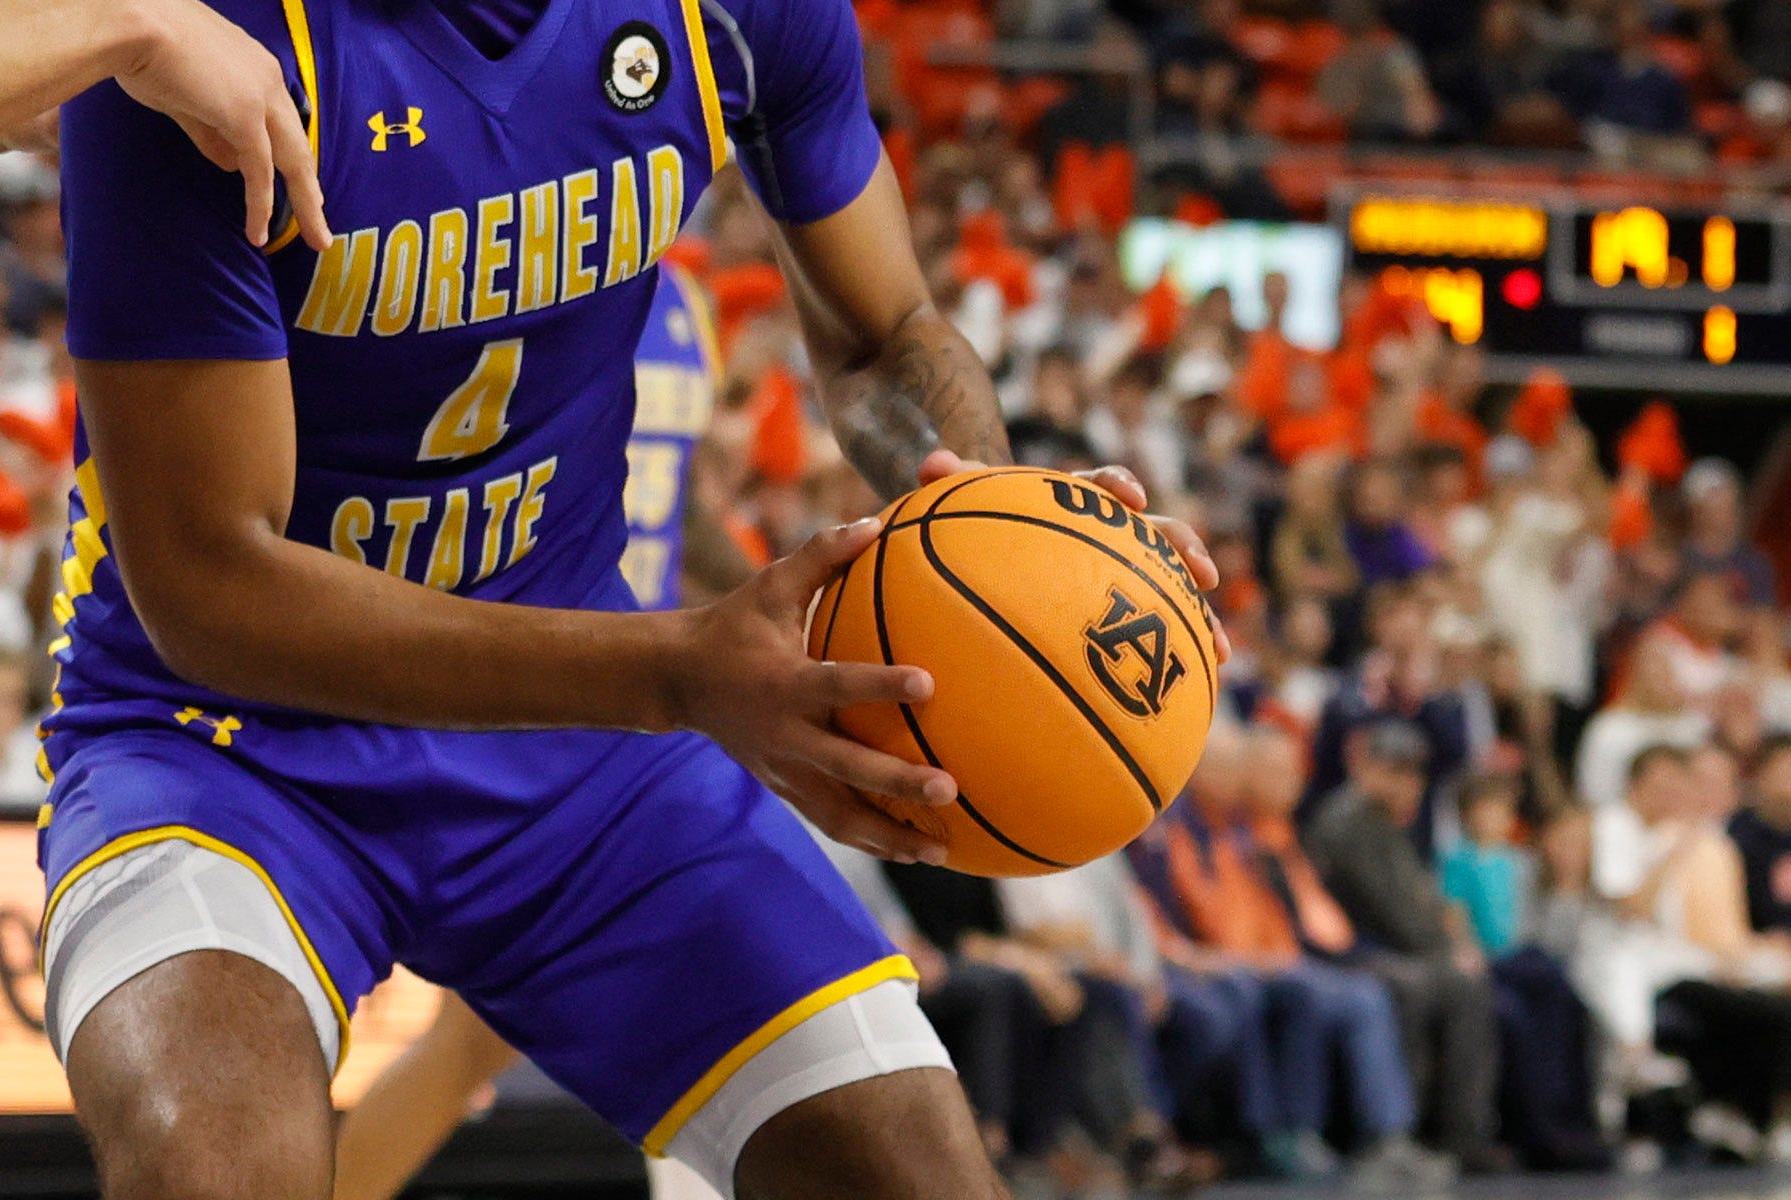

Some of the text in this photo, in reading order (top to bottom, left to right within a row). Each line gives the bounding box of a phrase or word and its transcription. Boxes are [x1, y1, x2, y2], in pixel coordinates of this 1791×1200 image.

[294, 144, 685, 338] MOREHEAD
[415, 337, 524, 462] 4
[329, 456, 558, 594] STATE
